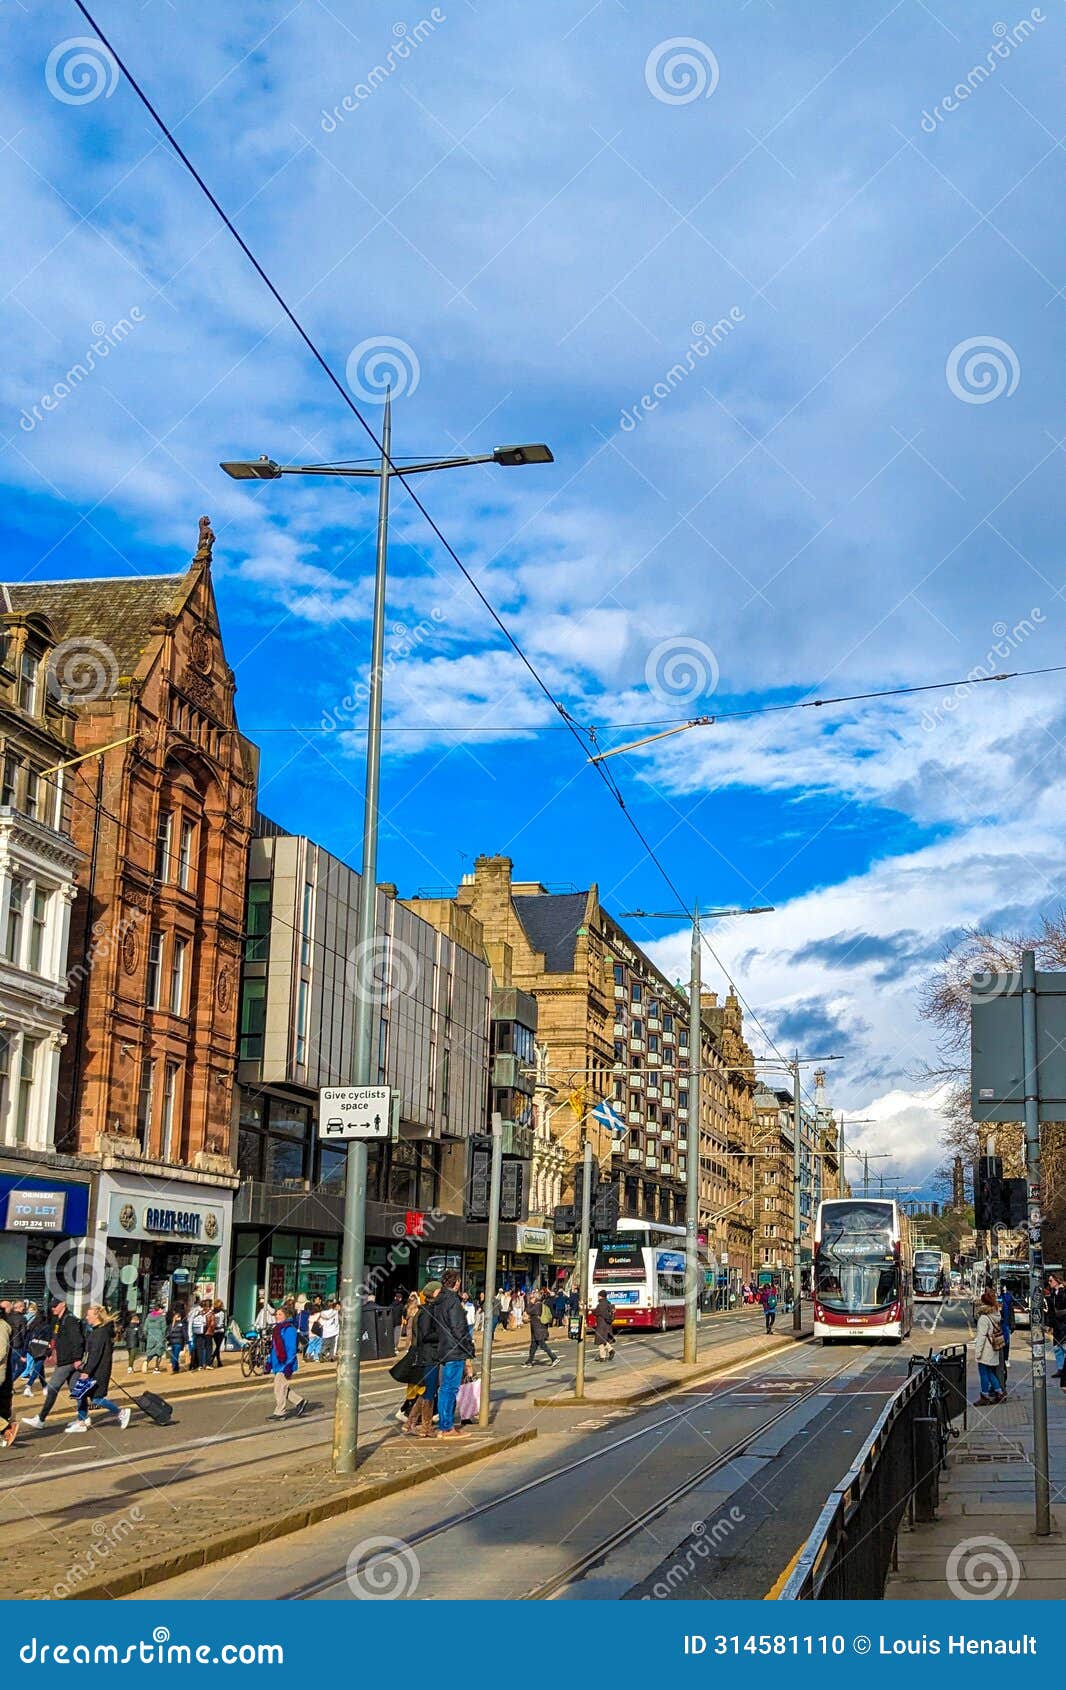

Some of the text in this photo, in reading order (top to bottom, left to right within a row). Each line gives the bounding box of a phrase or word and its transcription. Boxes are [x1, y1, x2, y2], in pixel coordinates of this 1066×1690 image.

[324, 1090, 386, 1100] Give cyclists
[340, 1103, 369, 1111] space
[15, 1204, 57, 1215] TO LET
